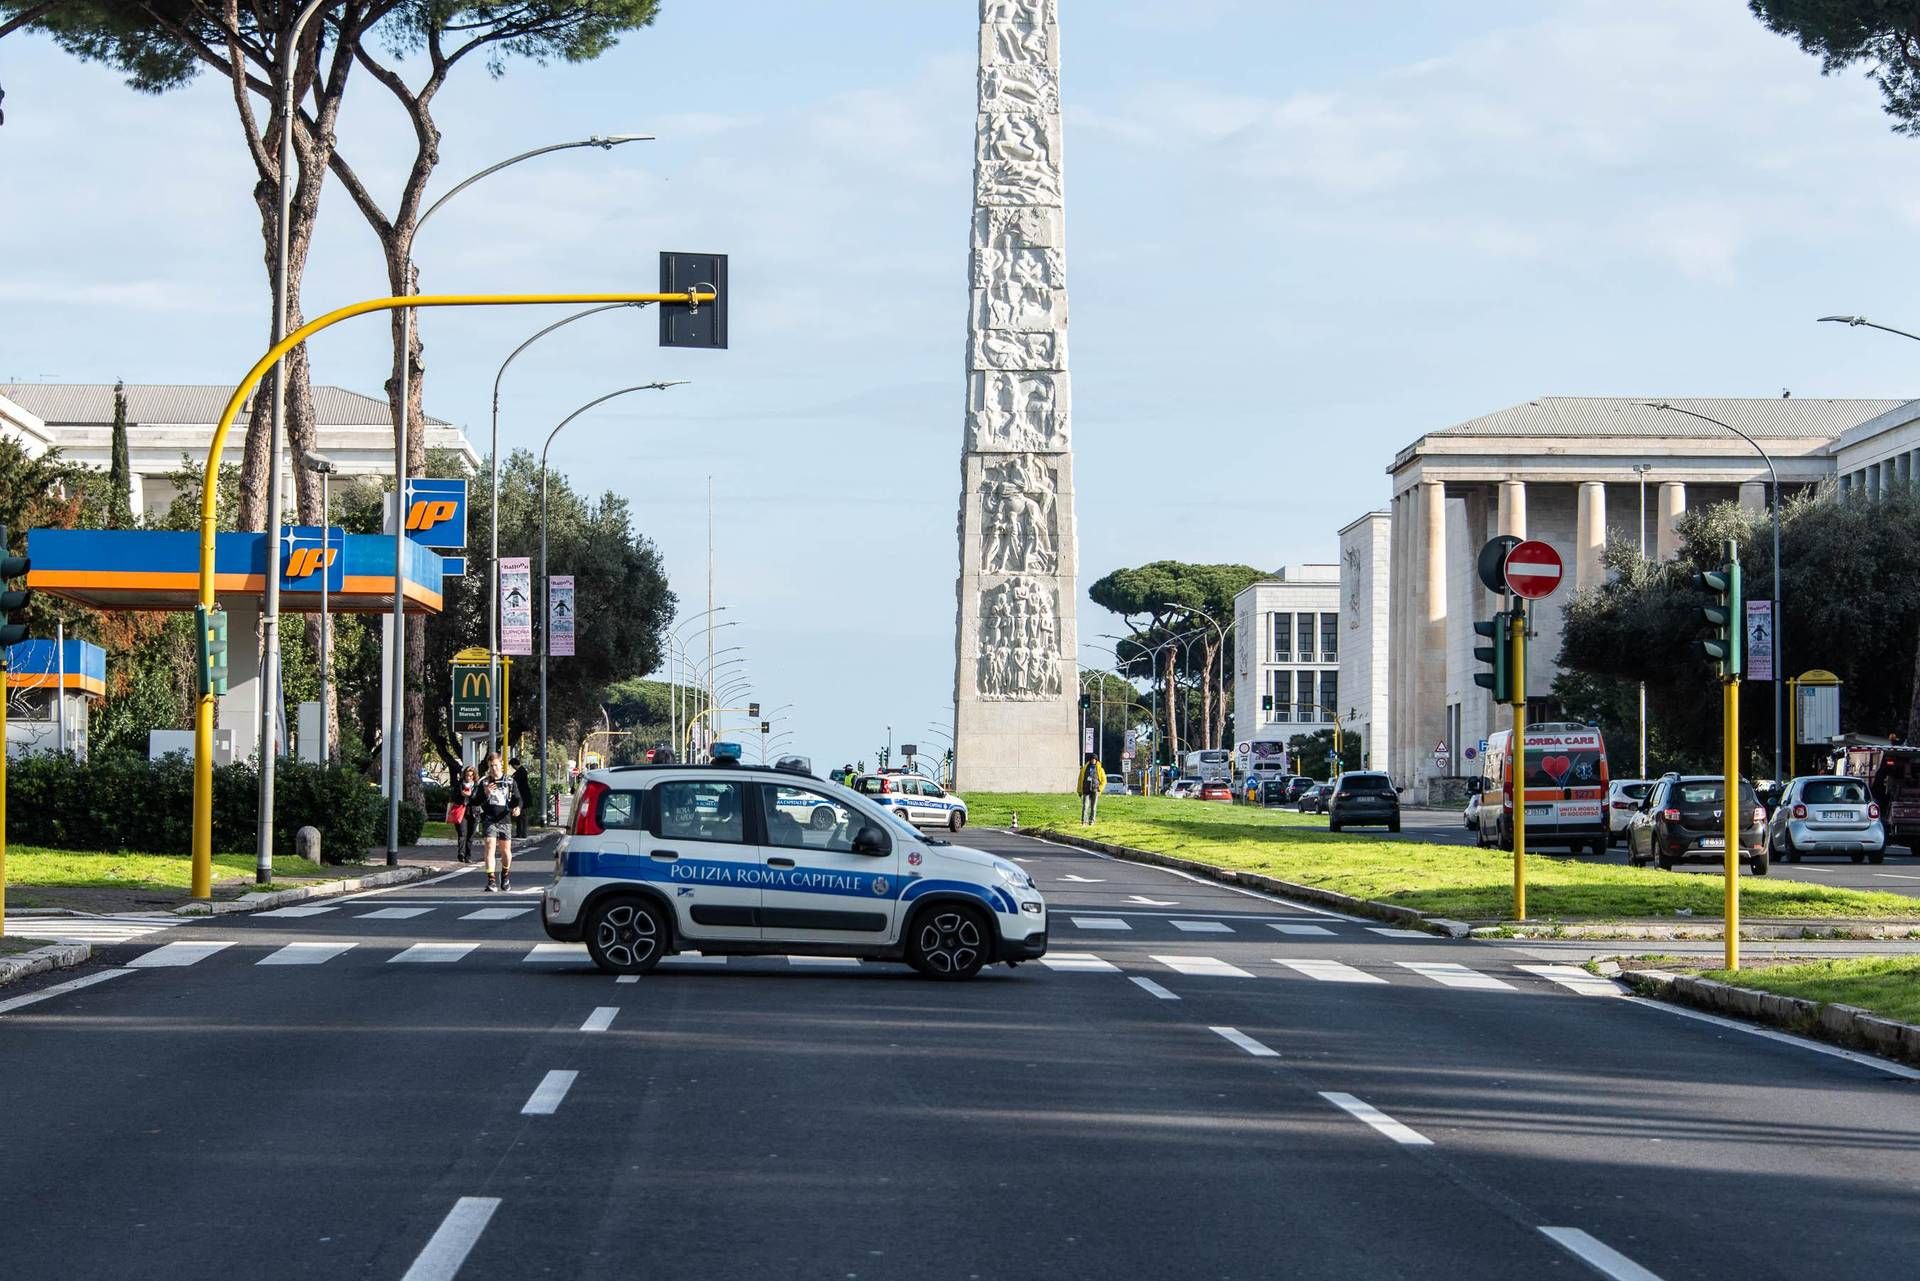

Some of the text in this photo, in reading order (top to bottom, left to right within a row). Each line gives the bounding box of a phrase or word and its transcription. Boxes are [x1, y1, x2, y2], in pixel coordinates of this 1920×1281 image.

[405, 500, 458, 530] IP
[285, 548, 338, 577] IP
[1524, 736, 1594, 746] LORIDA CARE
[670, 864, 863, 891] POLIZIA ROMA CAPITALE
